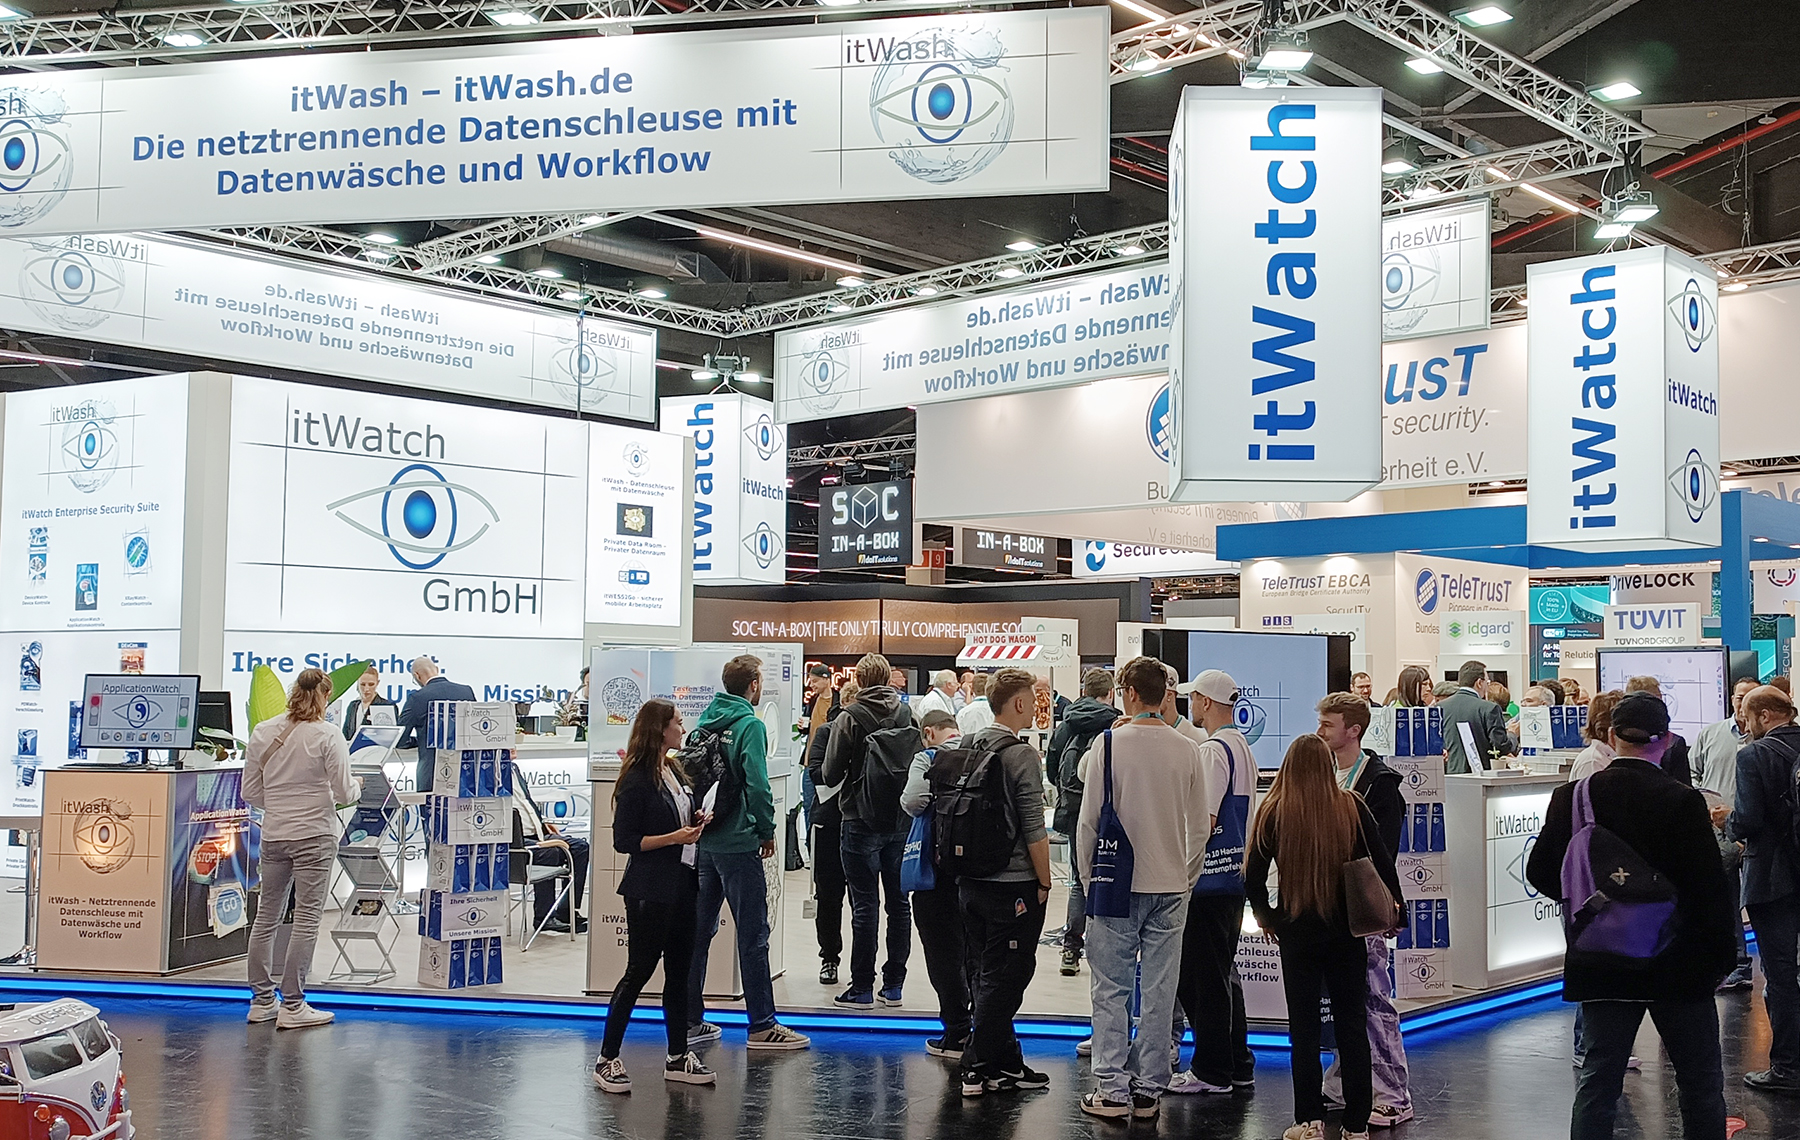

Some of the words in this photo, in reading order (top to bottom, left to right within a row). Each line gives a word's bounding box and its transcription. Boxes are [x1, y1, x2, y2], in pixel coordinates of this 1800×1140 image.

[846, 33, 949, 65] itWash
[291, 79, 408, 112] itWash
[454, 68, 633, 103] itWash.de
[133, 135, 185, 161] Die
[197, 118, 446, 157] netztrennende
[458, 106, 723, 143] Datenschleuse
[736, 97, 797, 128] mit
[217, 160, 446, 195] Datenwäsche
[458, 153, 523, 184] und
[538, 146, 711, 181] Workflow
[1249, 104, 1317, 461] itWatch
[1384, 344, 1488, 405] usT
[1570, 264, 1617, 530] itWatch
[1668, 378, 1717, 417] itWatch
[52, 404, 95, 422] itWash
[1392, 406, 1488, 435] security.
[293, 409, 446, 460] itWatch
[1382, 456, 1437, 481] erheit
[1446, 451, 1487, 475] e.V.
[742, 477, 783, 500] itWatch
[1148, 482, 1169, 500] Bu
[22, 508, 53, 519] itWatch
[55, 506, 98, 518] Enterprise
[100, 503, 135, 516] Security
[136, 501, 160, 513] Suite
[832, 532, 900, 553] IN-A-BOX
[977, 531, 1044, 554] IN-A-BOX
[1262, 576, 1325, 590] TeleTrusT
[1328, 574, 1371, 588] EBCA
[1441, 574, 1512, 602] TeleTrusT
[423, 579, 537, 614] GmbH
[839, 620, 869, 637] ONLY
[1416, 622, 1440, 634] Bundes
[1614, 609, 1686, 630] TÜVIT
[973, 635, 988, 643] HOT
[990, 635, 1006, 643] DOG
[1008, 635, 1036, 643] WAGON
[231, 651, 294, 673] Ihre
[103, 684, 180, 693] ApplicationWatch
[1237, 686, 1260, 697] atch
[524, 771, 571, 786] Watch
[63, 801, 109, 813] itWash
[480, 829, 504, 837] GmbH
[1496, 812, 1540, 836] itWatch
[48, 896, 79, 905] itWash
[89, 897, 156, 908] Netztrennende
[222, 897, 238, 912] GO
[1535, 901, 1563, 920] Gmb
[59, 908, 126, 918] Datenschleuse
[128, 909, 143, 918] mit
[602, 915, 626, 923] itWa
[60, 918, 122, 929] Datenwäsche
[123, 920, 141, 929] und
[616, 927, 629, 935] Da
[78, 930, 123, 940] Workflow
[617, 939, 629, 947] Da
[1235, 947, 1281, 957] chleuse
[1234, 960, 1277, 969] wäsche
